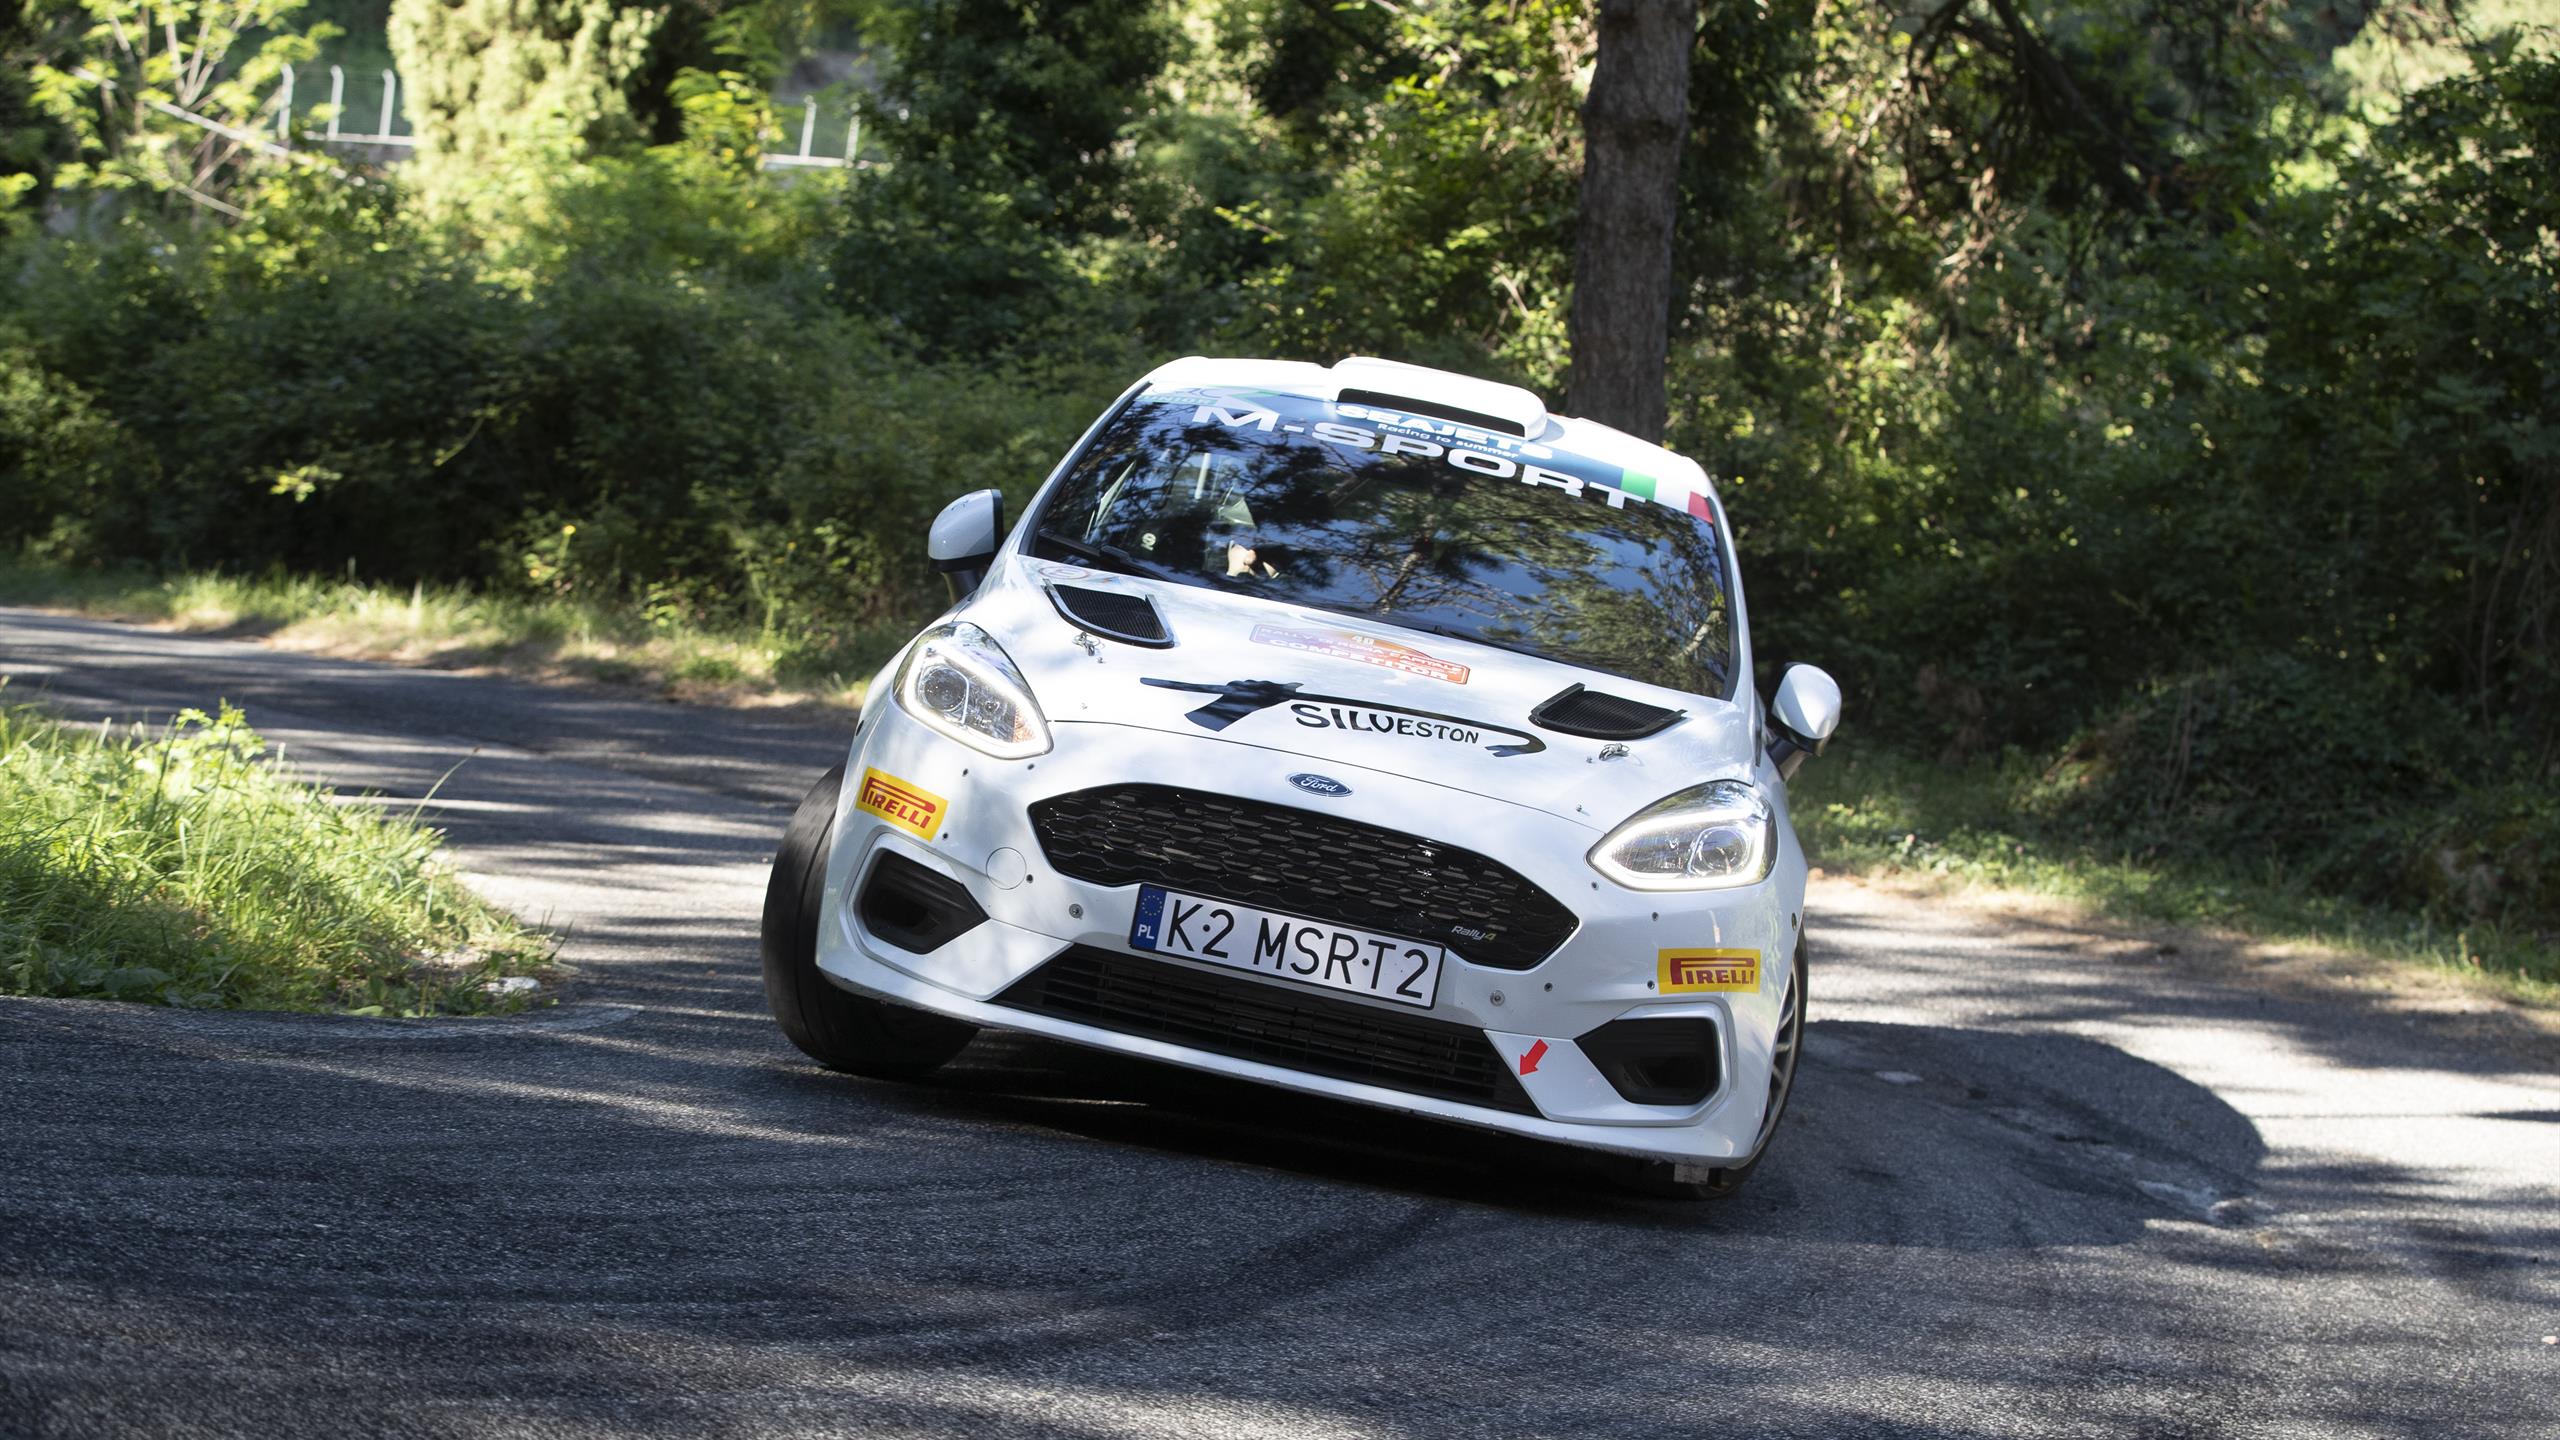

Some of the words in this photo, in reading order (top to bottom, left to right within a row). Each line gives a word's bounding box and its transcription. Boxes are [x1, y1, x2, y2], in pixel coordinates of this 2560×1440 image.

[1336, 404, 1552, 460] SEAJETS
[1377, 423, 1430, 440] Racing
[1436, 435, 1452, 443] to
[1456, 441, 1520, 459] summer
[1192, 405, 1647, 510] M-SPORT
[1268, 639, 1449, 681] COMPETITOR
[1290, 703, 1479, 744] SILVESTON
[862, 775, 937, 829] PIRELLI
[1301, 776, 1338, 792] Ford
[1137, 923, 1155, 940] PL
[1669, 957, 1756, 985] PIRELLI
